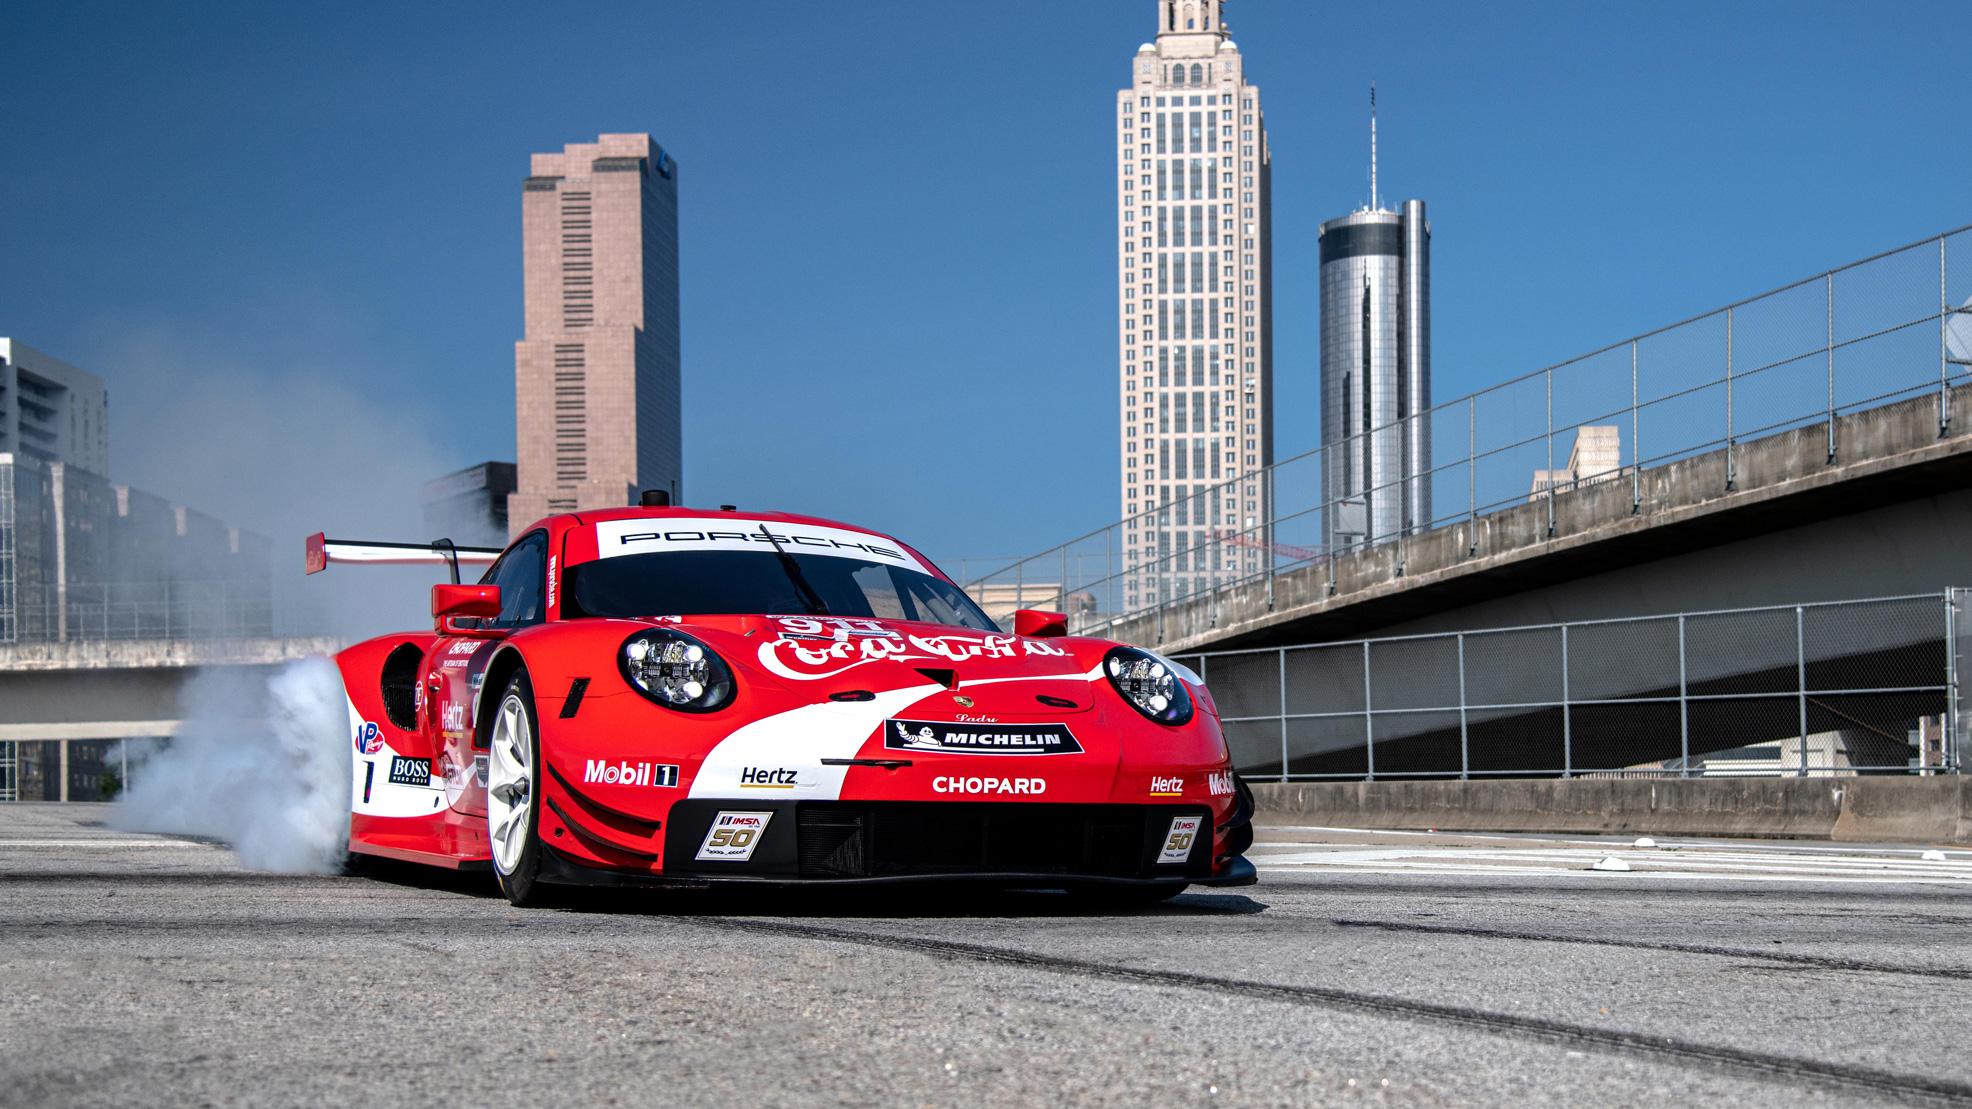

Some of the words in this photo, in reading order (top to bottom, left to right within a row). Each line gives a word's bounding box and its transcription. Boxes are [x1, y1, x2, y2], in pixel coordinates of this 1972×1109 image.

[620, 531, 906, 561] PORSCHE
[442, 701, 464, 731] Hertz
[358, 722, 378, 755] VP
[944, 732, 1062, 745] MICHELIN
[393, 758, 429, 778] BOSS
[584, 760, 651, 786] Mobil
[932, 776, 1046, 794] CHOPARD
[1150, 776, 1184, 792] Hertz
[732, 817, 761, 825] IMSA
[709, 828, 757, 848] 50
[1166, 833, 1194, 851] 50
